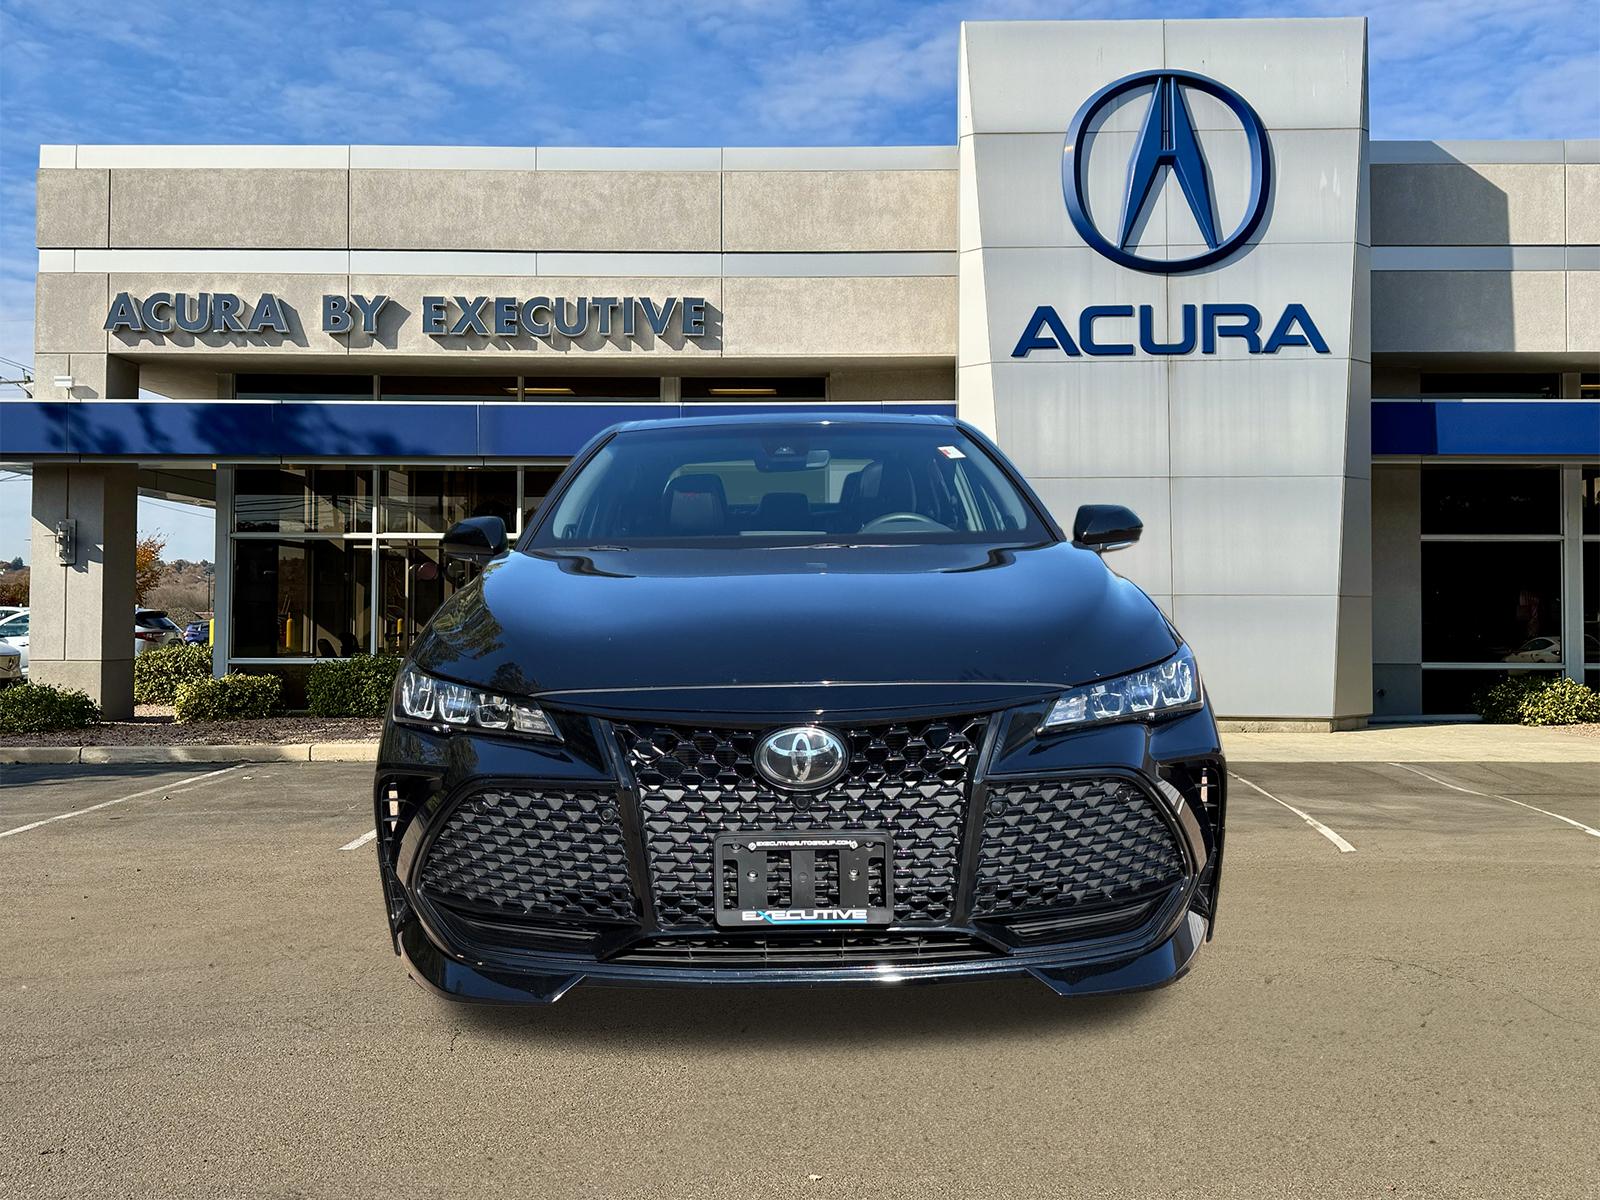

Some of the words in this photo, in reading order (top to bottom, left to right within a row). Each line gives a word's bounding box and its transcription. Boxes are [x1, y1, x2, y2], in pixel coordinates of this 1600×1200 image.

[103, 292, 289, 333] ACURA
[322, 295, 391, 334] BY
[422, 296, 706, 337] EXECUTIVE
[1011, 303, 1333, 357] ACURA
[741, 909, 867, 922] EXECUTIVE
